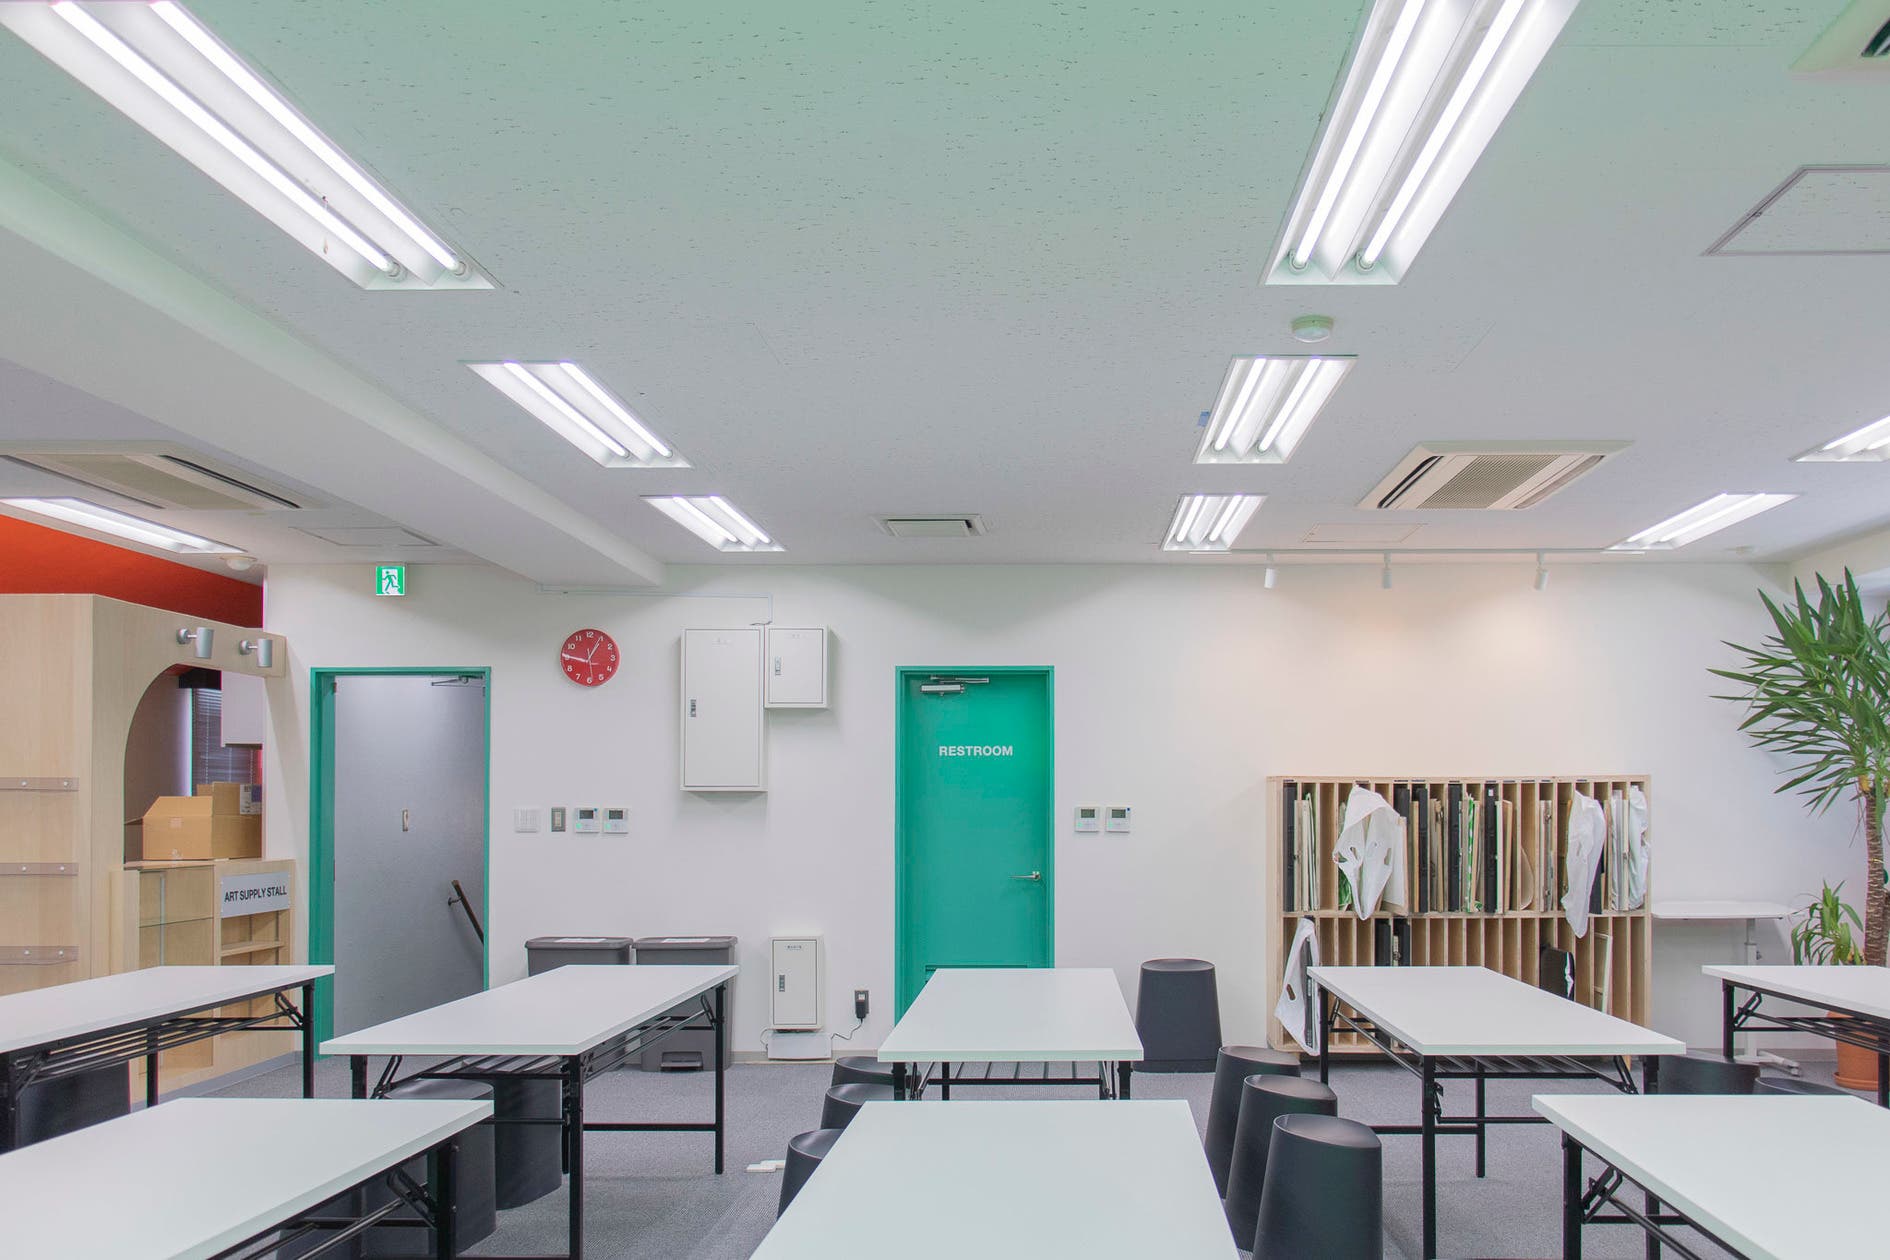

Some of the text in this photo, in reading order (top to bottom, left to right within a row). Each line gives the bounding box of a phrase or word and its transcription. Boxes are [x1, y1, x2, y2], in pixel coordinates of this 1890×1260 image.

[938, 745, 1013, 757] RESTROOM
[224, 885, 287, 902] ART SUPPLY STALL
